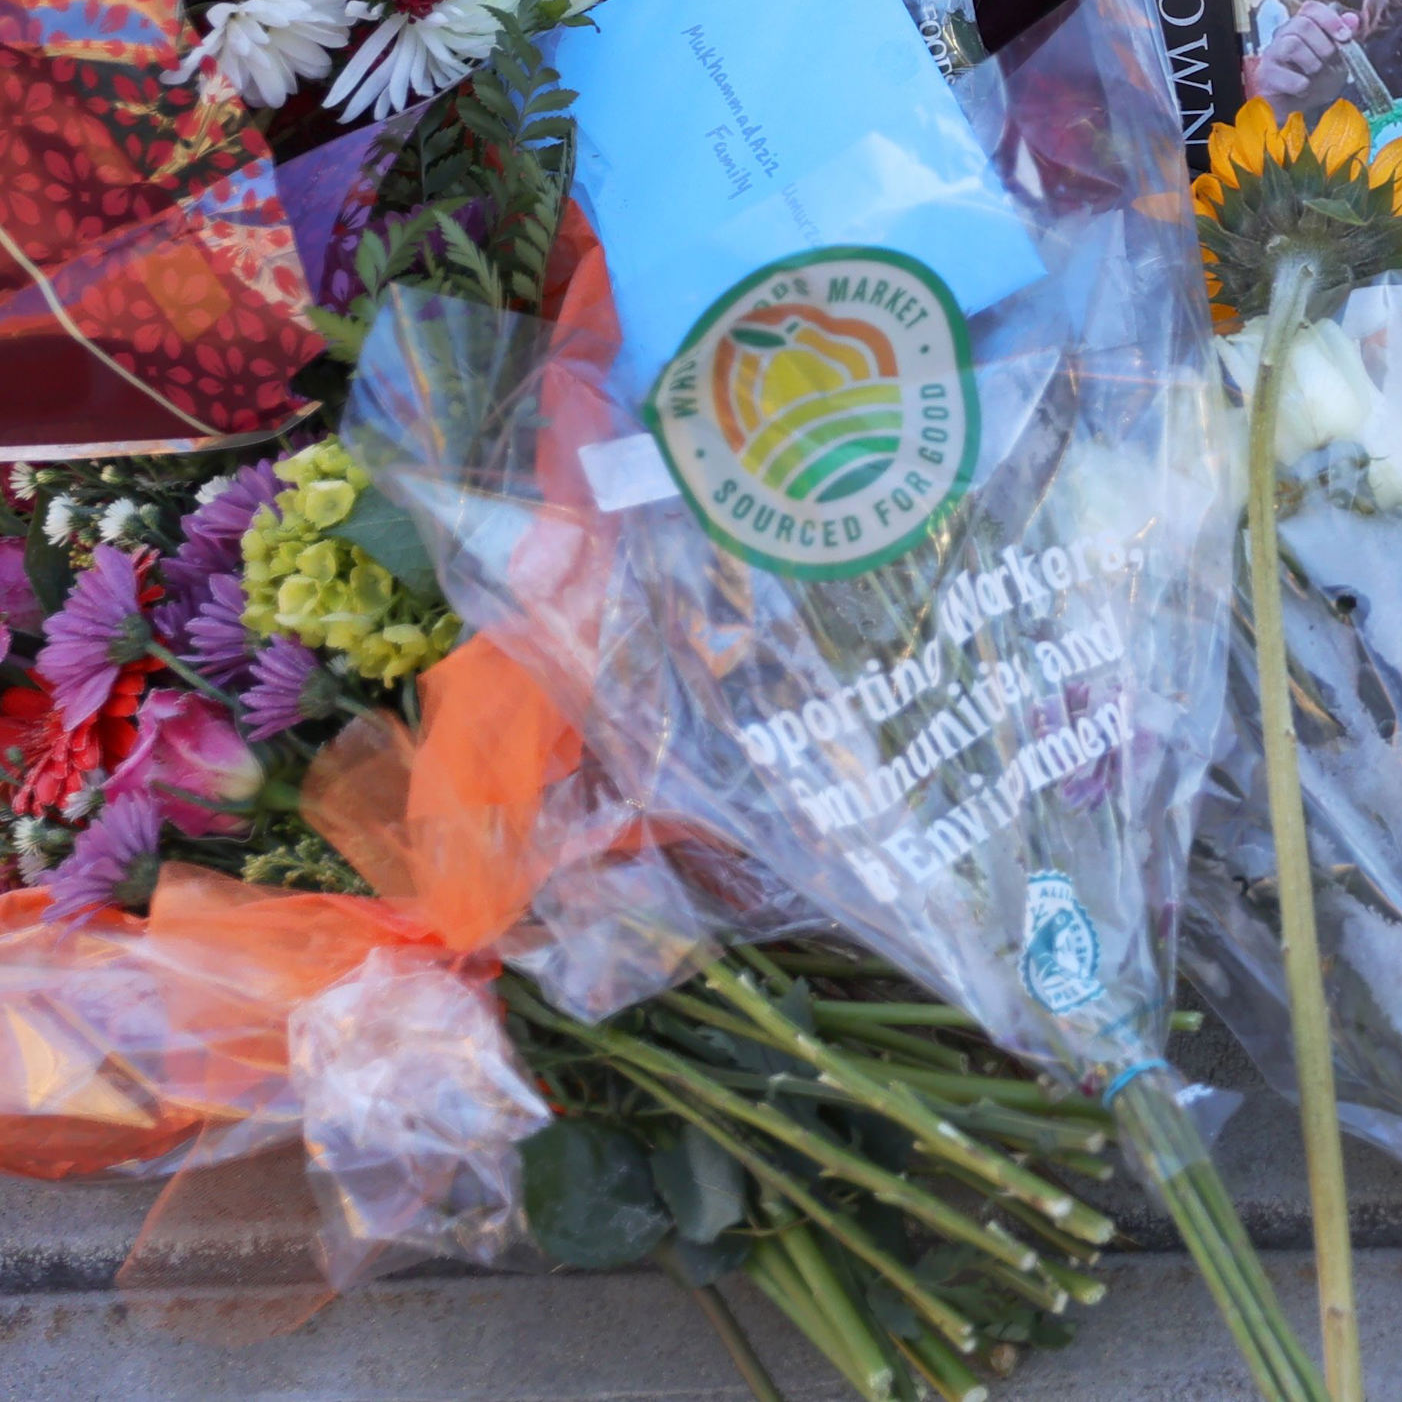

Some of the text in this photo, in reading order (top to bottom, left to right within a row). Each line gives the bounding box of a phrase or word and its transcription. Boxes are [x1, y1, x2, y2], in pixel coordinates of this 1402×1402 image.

[705, 124, 753, 200] Family
[828, 277, 929, 329] MARKET
[714, 383, 948, 548] SOURCED FOR GOOD
[1034, 602, 1124, 683] and
